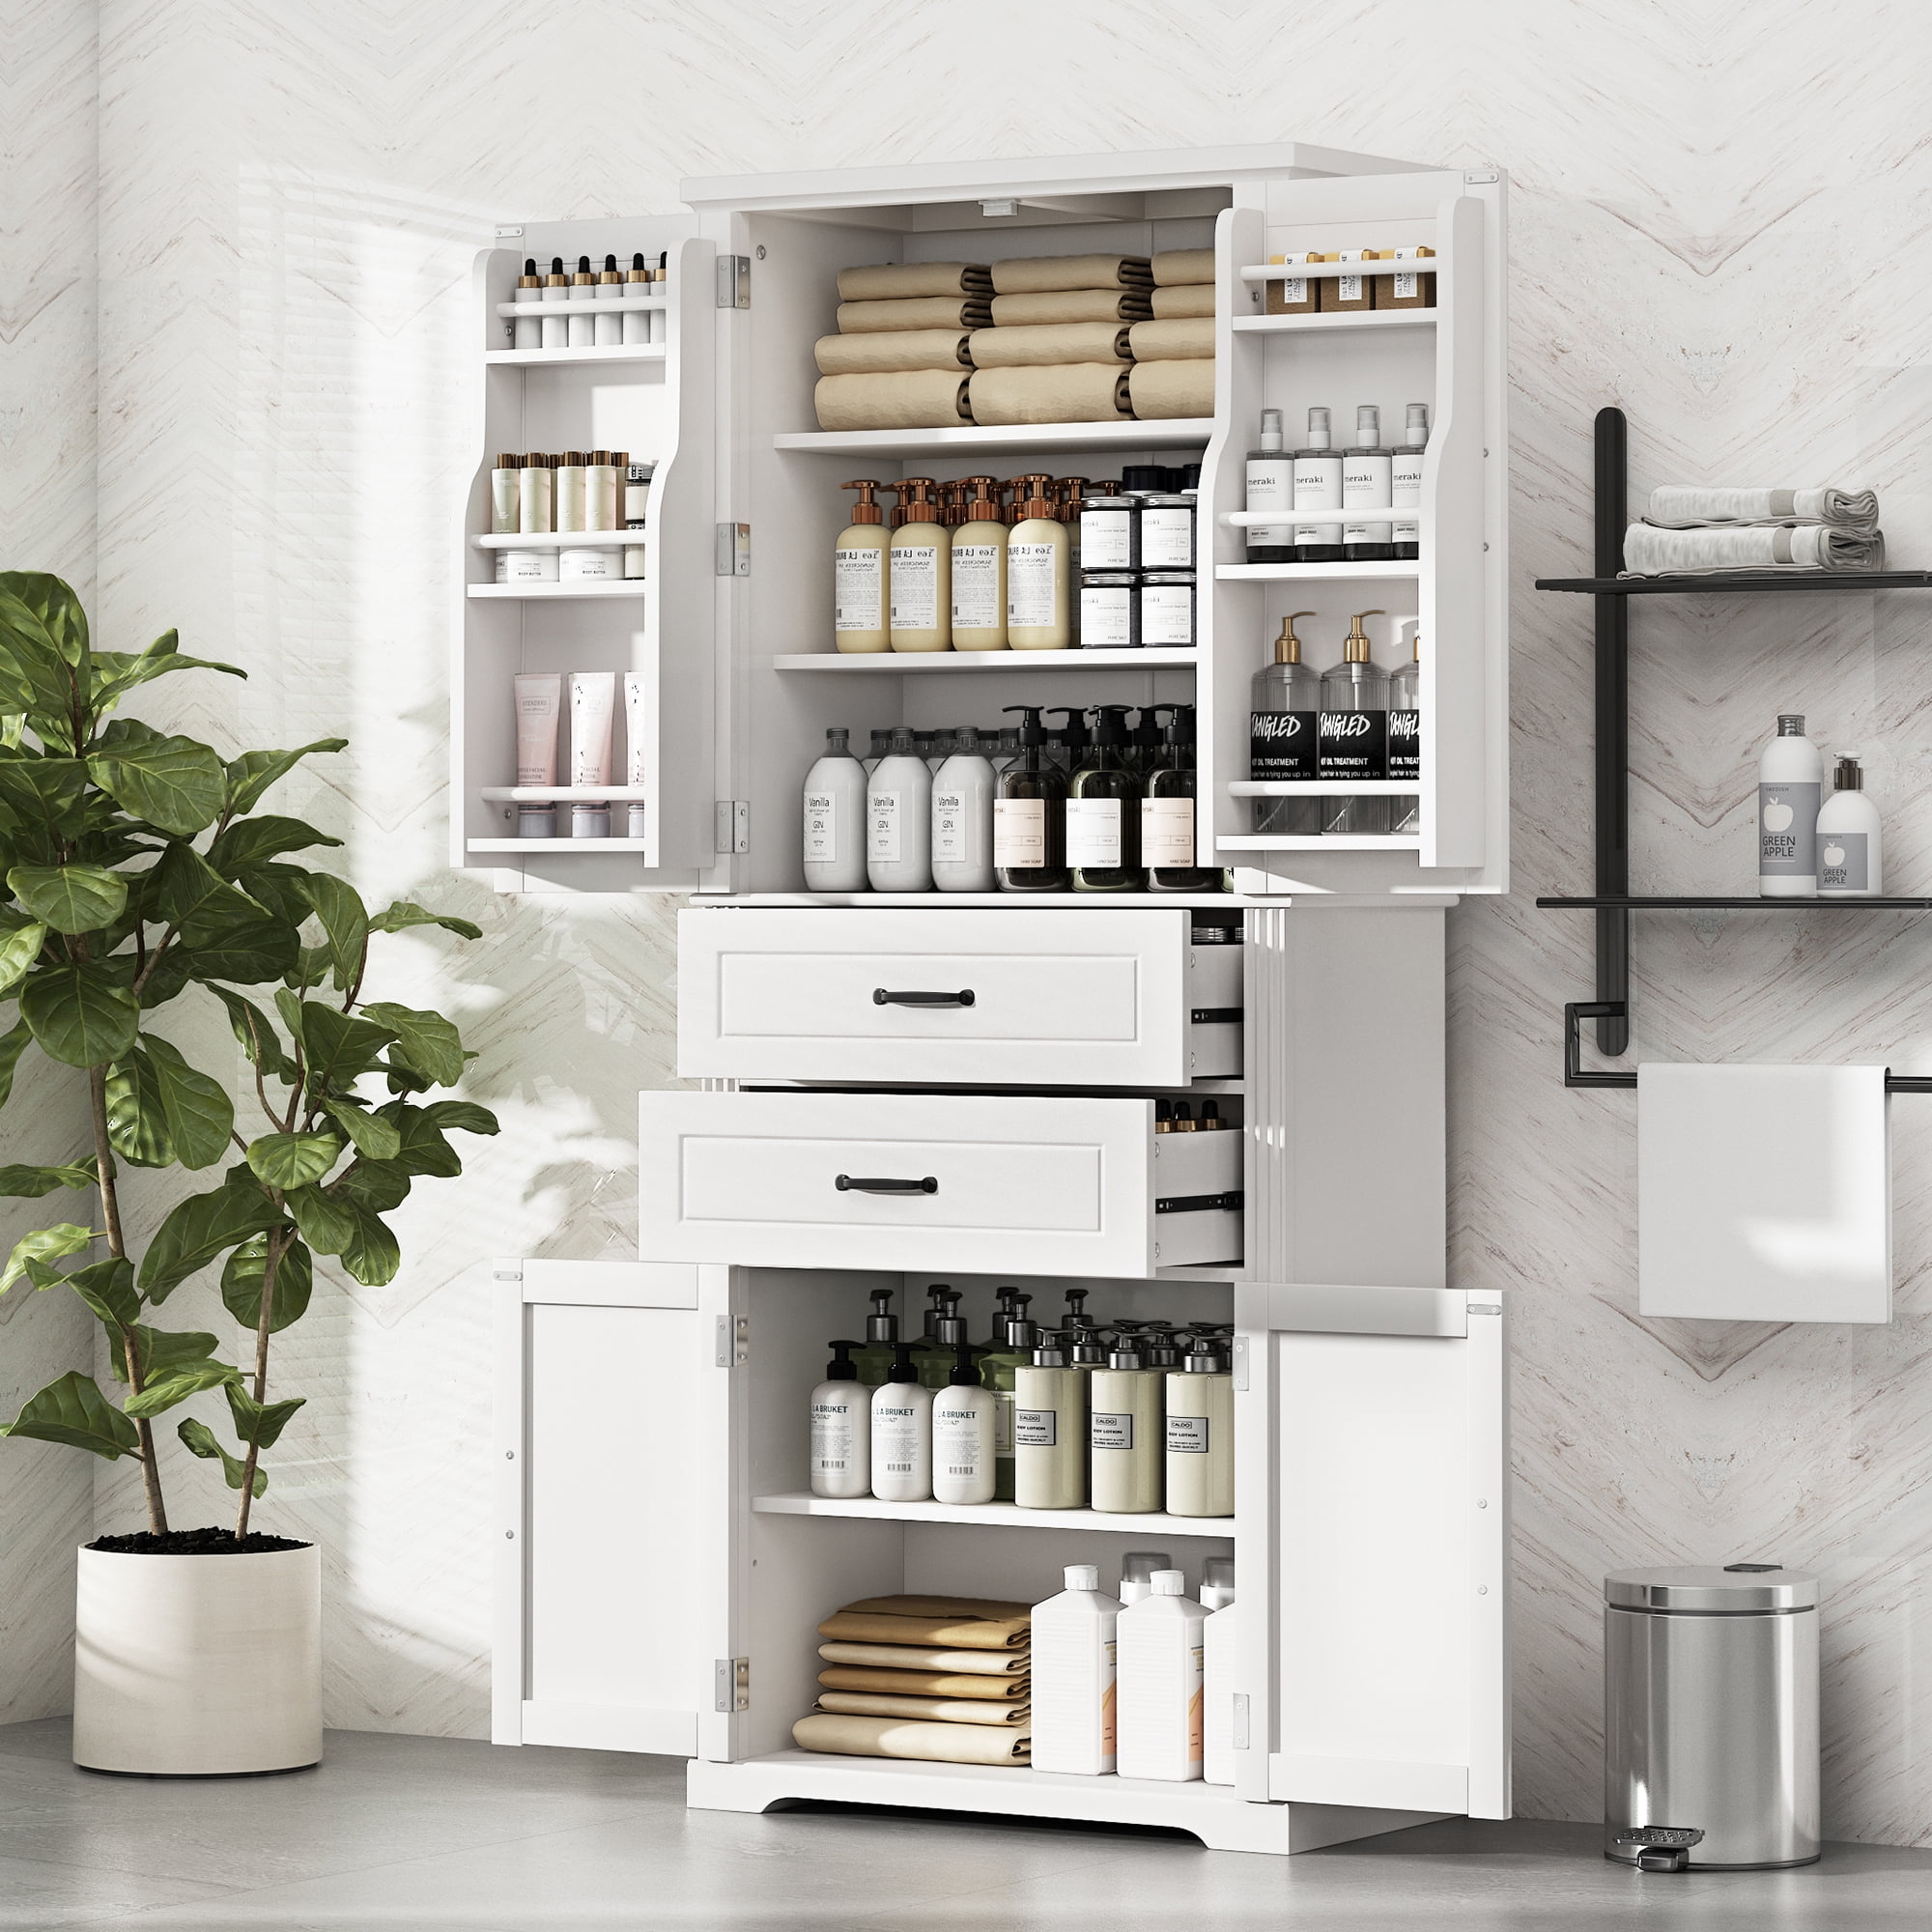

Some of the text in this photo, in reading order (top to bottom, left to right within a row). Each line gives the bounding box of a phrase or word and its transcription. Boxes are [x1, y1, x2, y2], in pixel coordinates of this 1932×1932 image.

[810, 797, 829, 807] Vanilla
[874, 797, 894, 806] Vanilla
[938, 796, 958, 806] Vanilla
[813, 820, 824, 829] GIN
[1763, 836, 1796, 846] GREEN
[1763, 847, 1794, 857] APPLE
[886, 1407, 915, 1416] BRUKET
[947, 1410, 977, 1419] BRUKET
